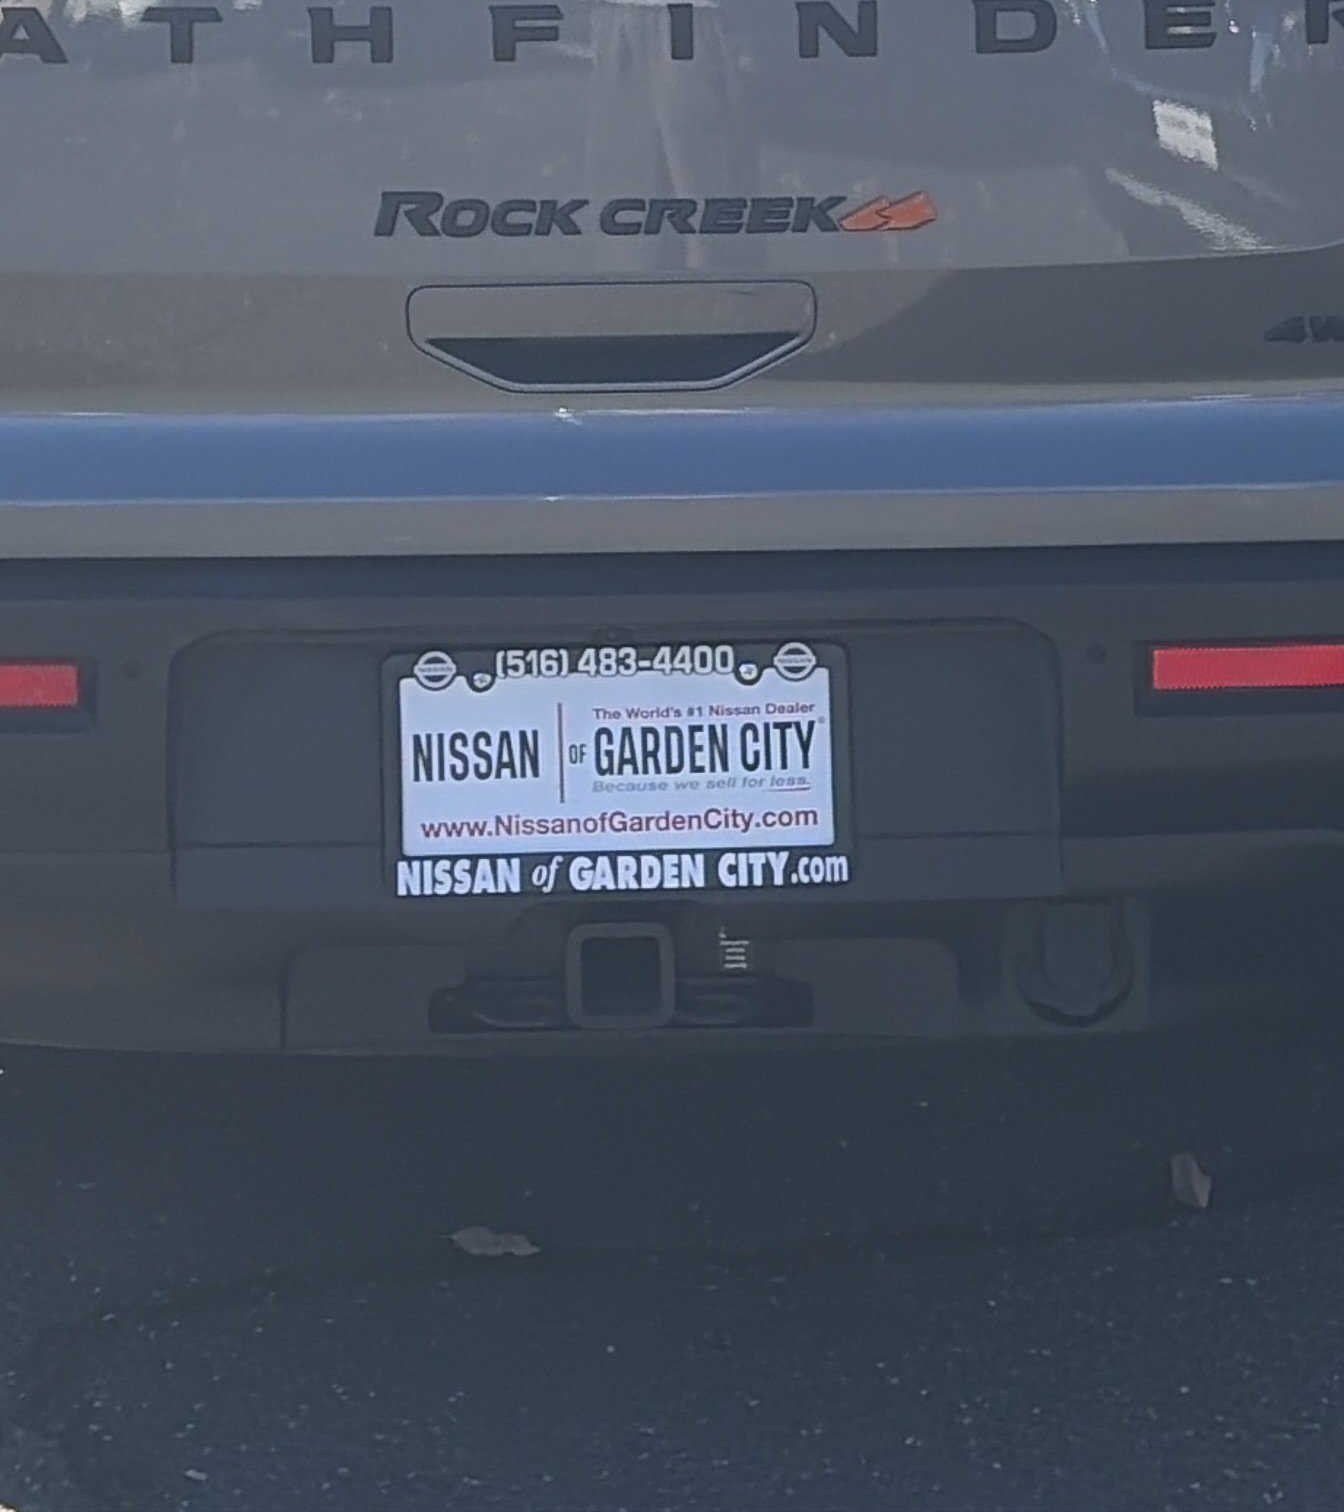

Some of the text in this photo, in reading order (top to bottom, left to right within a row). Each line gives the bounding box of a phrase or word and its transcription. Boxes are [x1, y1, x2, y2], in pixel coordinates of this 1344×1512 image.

[373, 190, 848, 238] ROCK CREEK
[496, 644, 735, 679] (516) 483-4400
[593, 701, 816, 720] The World's #1 Nissan Dealer
[412, 719, 816, 782] NISSAN OF GARDEN CITY
[592, 779, 667, 793] Because
[674, 779, 700, 790] we
[706, 776, 737, 790] sell
[742, 775, 766, 789] for
[421, 807, 818, 838] www.NissanofGardenCity.com
[397, 850, 849, 897] NISSAN of GARDEN CITY.com
